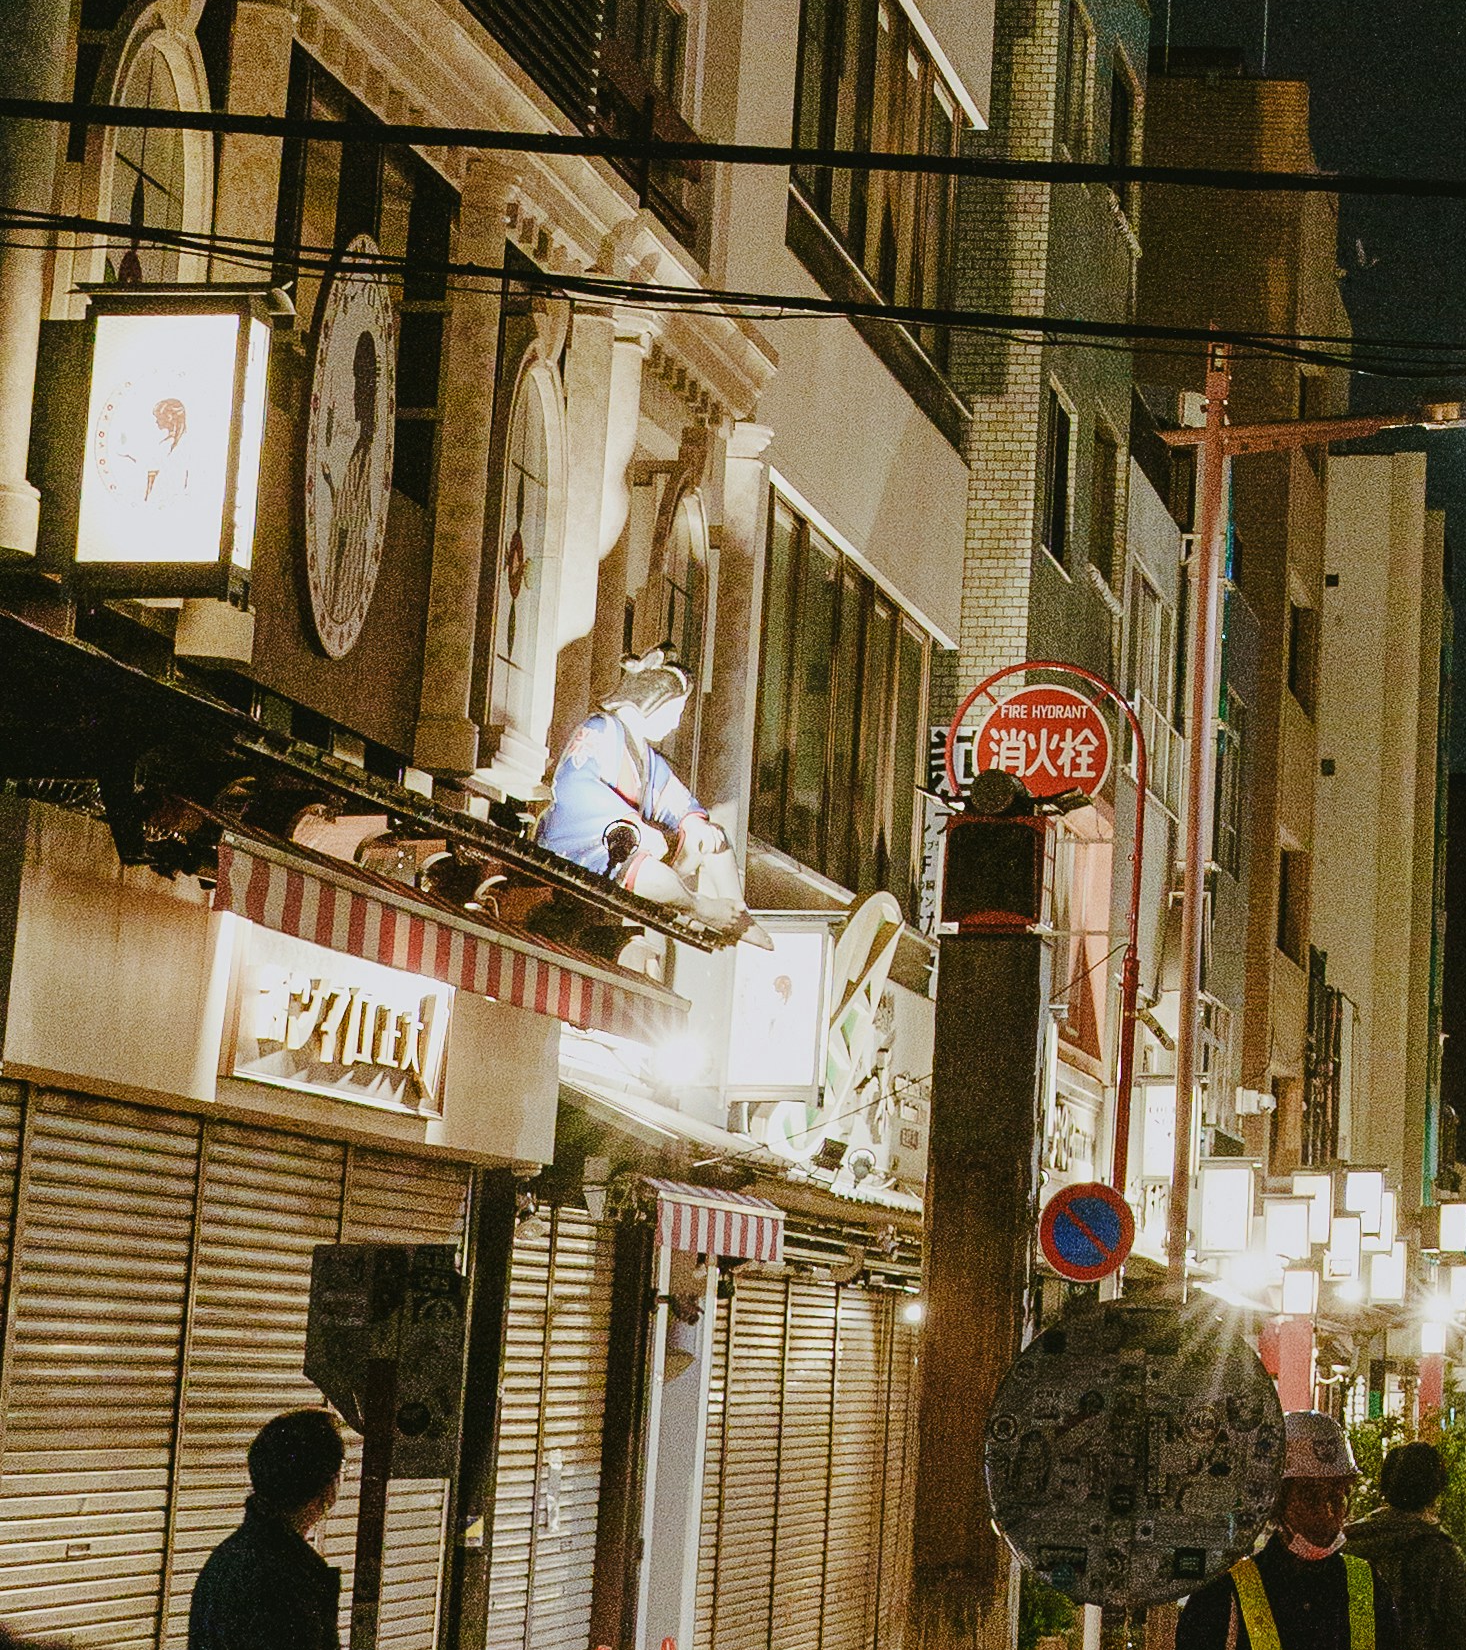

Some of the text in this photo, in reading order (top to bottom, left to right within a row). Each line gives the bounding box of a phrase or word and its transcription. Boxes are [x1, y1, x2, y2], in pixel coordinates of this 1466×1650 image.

[1000, 704, 1089, 719] FIRE HYDRANT
[989, 728, 1100, 778] 消火栓
